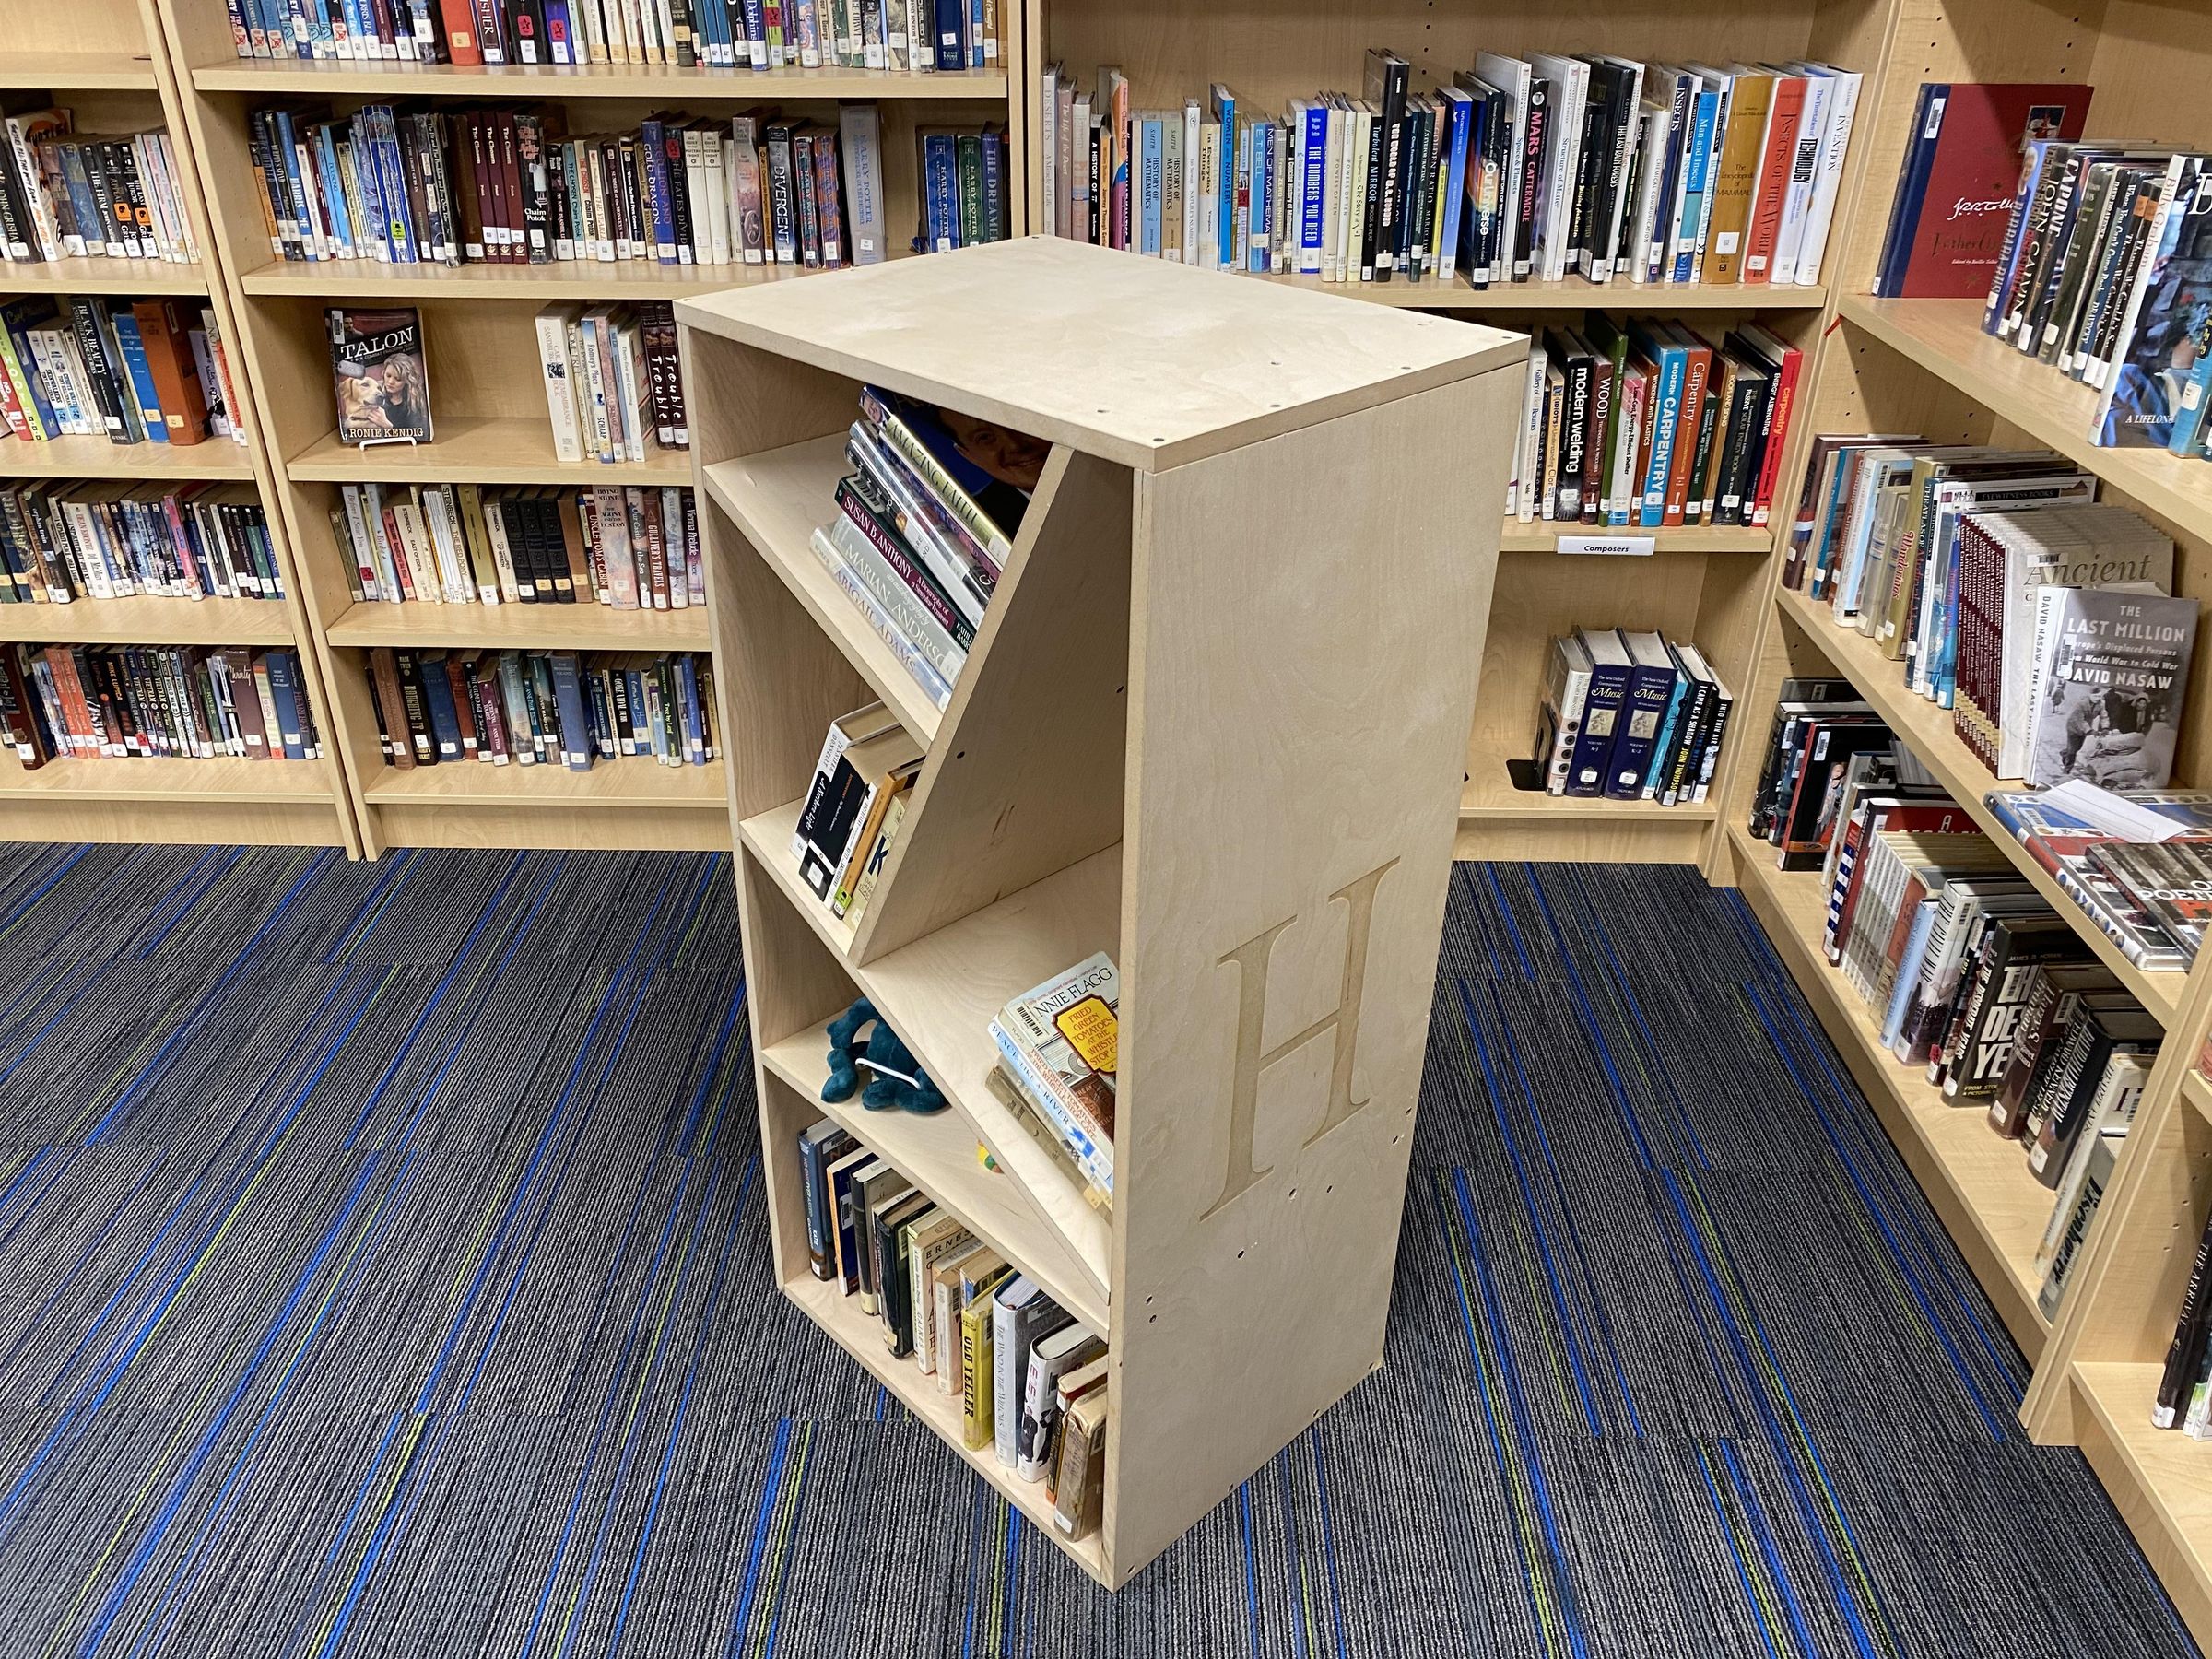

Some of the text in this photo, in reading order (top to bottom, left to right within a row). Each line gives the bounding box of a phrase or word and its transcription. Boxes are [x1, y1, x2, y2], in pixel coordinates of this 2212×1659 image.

[1044, 89, 1053, 141] DESERTS
[1671, 88, 1685, 132] INSECTS
[1368, 125, 1382, 202] Turbulent MIRROR
[1559, 137, 1569, 173] Structure
[1697, 135, 1705, 150] and
[1793, 137, 1818, 184] TECHNOLOGY
[1828, 114, 1845, 171] INVENTION
[1522, 111, 1543, 223] MARS CATTERMOLE
[1653, 159, 1662, 190] CHEMICAL
[1690, 155, 1701, 188] Insects
[524, 207, 547, 216] Chaim
[648, 176, 661, 225] DRAGON
[774, 165, 790, 244] DIVERGENT
[1305, 146, 1321, 241] THE NUMBERS YOU NEED
[1644, 191, 1657, 243] COMMUNICATION
[2034, 180, 2060, 235] JOHN
[2048, 158, 2080, 239] CAPONE
[526, 214, 547, 222] Potok
[2138, 216, 2166, 268] Graham
[2012, 240, 2040, 312] CALVIN
[78, 304, 108, 376] BLACK BEAUTY
[340, 325, 414, 360] TALON
[652, 356, 669, 420] Trouble
[665, 354, 683, 419] Trouble
[1596, 377, 1612, 419] WOOD
[1683, 362, 1705, 422] Carpentry
[349, 427, 423, 438] RONIE KENDIG
[1566, 367, 1588, 473] modern welding
[1651, 361, 1679, 491] MODERN CARPENTRY
[1761, 397, 1774, 437] ALTERNATIVES
[1773, 387, 1791, 436] carpentry
[2125, 415, 2133, 424] A
[888, 424, 978, 527] AMAZING FAITH
[1981, 488, 2054, 500] EYEWITNESS BOOKS
[442, 487, 457, 526] STEINBECK
[588, 514, 599, 541] UNCLE
[596, 562, 609, 587] CABIN
[648, 524, 665, 588] GULLIVER'S TRAVELS
[686, 509, 700, 556] Vienna Prelude
[843, 496, 871, 533] SUSAN
[876, 535, 913, 579] ANTHONY
[1584, 545, 1629, 554] Composers
[844, 547, 891, 602] MARIAN
[1892, 529, 1915, 599] Wanderings
[2023, 553, 2153, 587] Ancient
[834, 569, 917, 674] ABIGAIL ADAMS
[2035, 595, 2052, 664] DAVID NASAW
[2066, 618, 2186, 642] LAST MILLION
[2120, 605, 2142, 618] THE
[2085, 654, 2179, 671] World War to Cold War
[2105, 641, 2144, 653] Displaced
[2146, 646, 2178, 657] Persons
[228, 665, 252, 688] Christy
[1592, 687, 1624, 699] Music
[1634, 688, 1667, 701] Music
[2115, 672, 2173, 689] NASAW
[1713, 719, 1724, 735] THIN
[1716, 703, 1727, 719] INTO
[1034, 967, 1112, 1018] NNIE FLAGG
[1067, 1006, 1093, 1023] FRIED
[1964, 983, 1986, 1035] DESPERATE
[2019, 978, 2048, 1033] Truman
[2037, 985, 2056, 1029] Harry
[1072, 1017, 1113, 1043] TOMATOES
[1073, 1012, 1100, 1031] GREEN
[1199, 855, 1401, 1223] H
[1089, 1047, 1112, 1066] STOP
[1956, 1032, 1971, 1060] YEARS
[991, 1025, 1018, 1058] PEACE
[1019, 1061, 1034, 1081] LIKE
[1043, 1091, 1070, 1125] RIVER
[1065, 1092, 1098, 1134] TOMATOES
[2053, 1175, 2103, 1286] Eisenhower
[2179, 1243, 2210, 1327] THE ARRIVAL
[916, 1312, 925, 1349] GAINES
[962, 1335, 974, 1418] OLD YELLER
